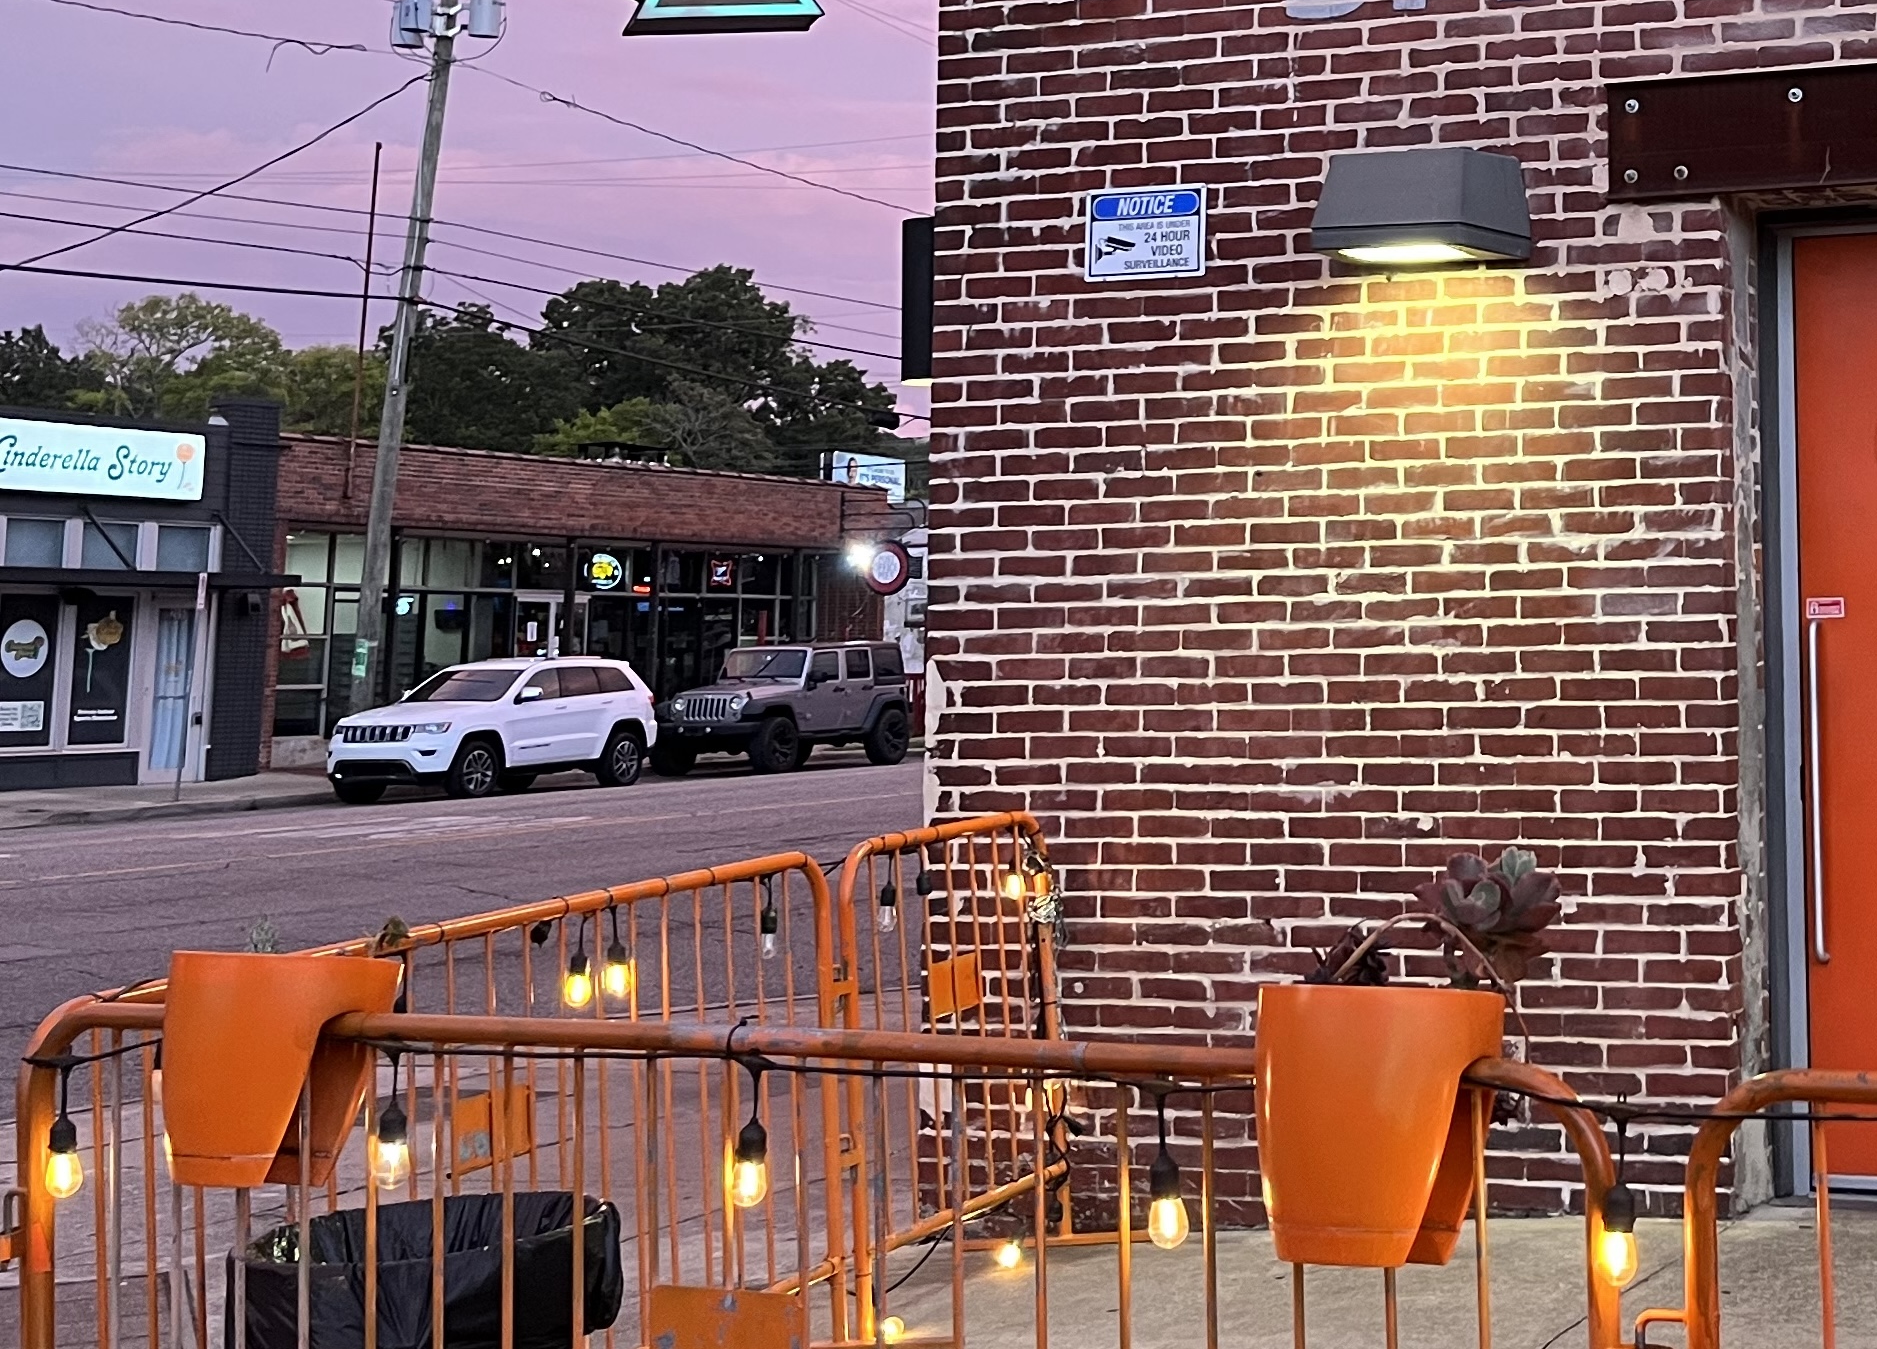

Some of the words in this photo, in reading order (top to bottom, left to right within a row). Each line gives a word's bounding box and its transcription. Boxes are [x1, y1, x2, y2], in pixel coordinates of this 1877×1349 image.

[1117, 195, 1175, 216] NOTICE
[1118, 223, 1134, 231] THIS
[1136, 222, 1154, 230] AREA
[1157, 221, 1163, 229] IS
[1144, 232, 1157, 243] 24
[1161, 230, 1190, 241] HOUR
[1151, 244, 1183, 256] VIDEO
[1124, 257, 1190, 270] SURVEILLANCE
[107, 445, 173, 483] Story
